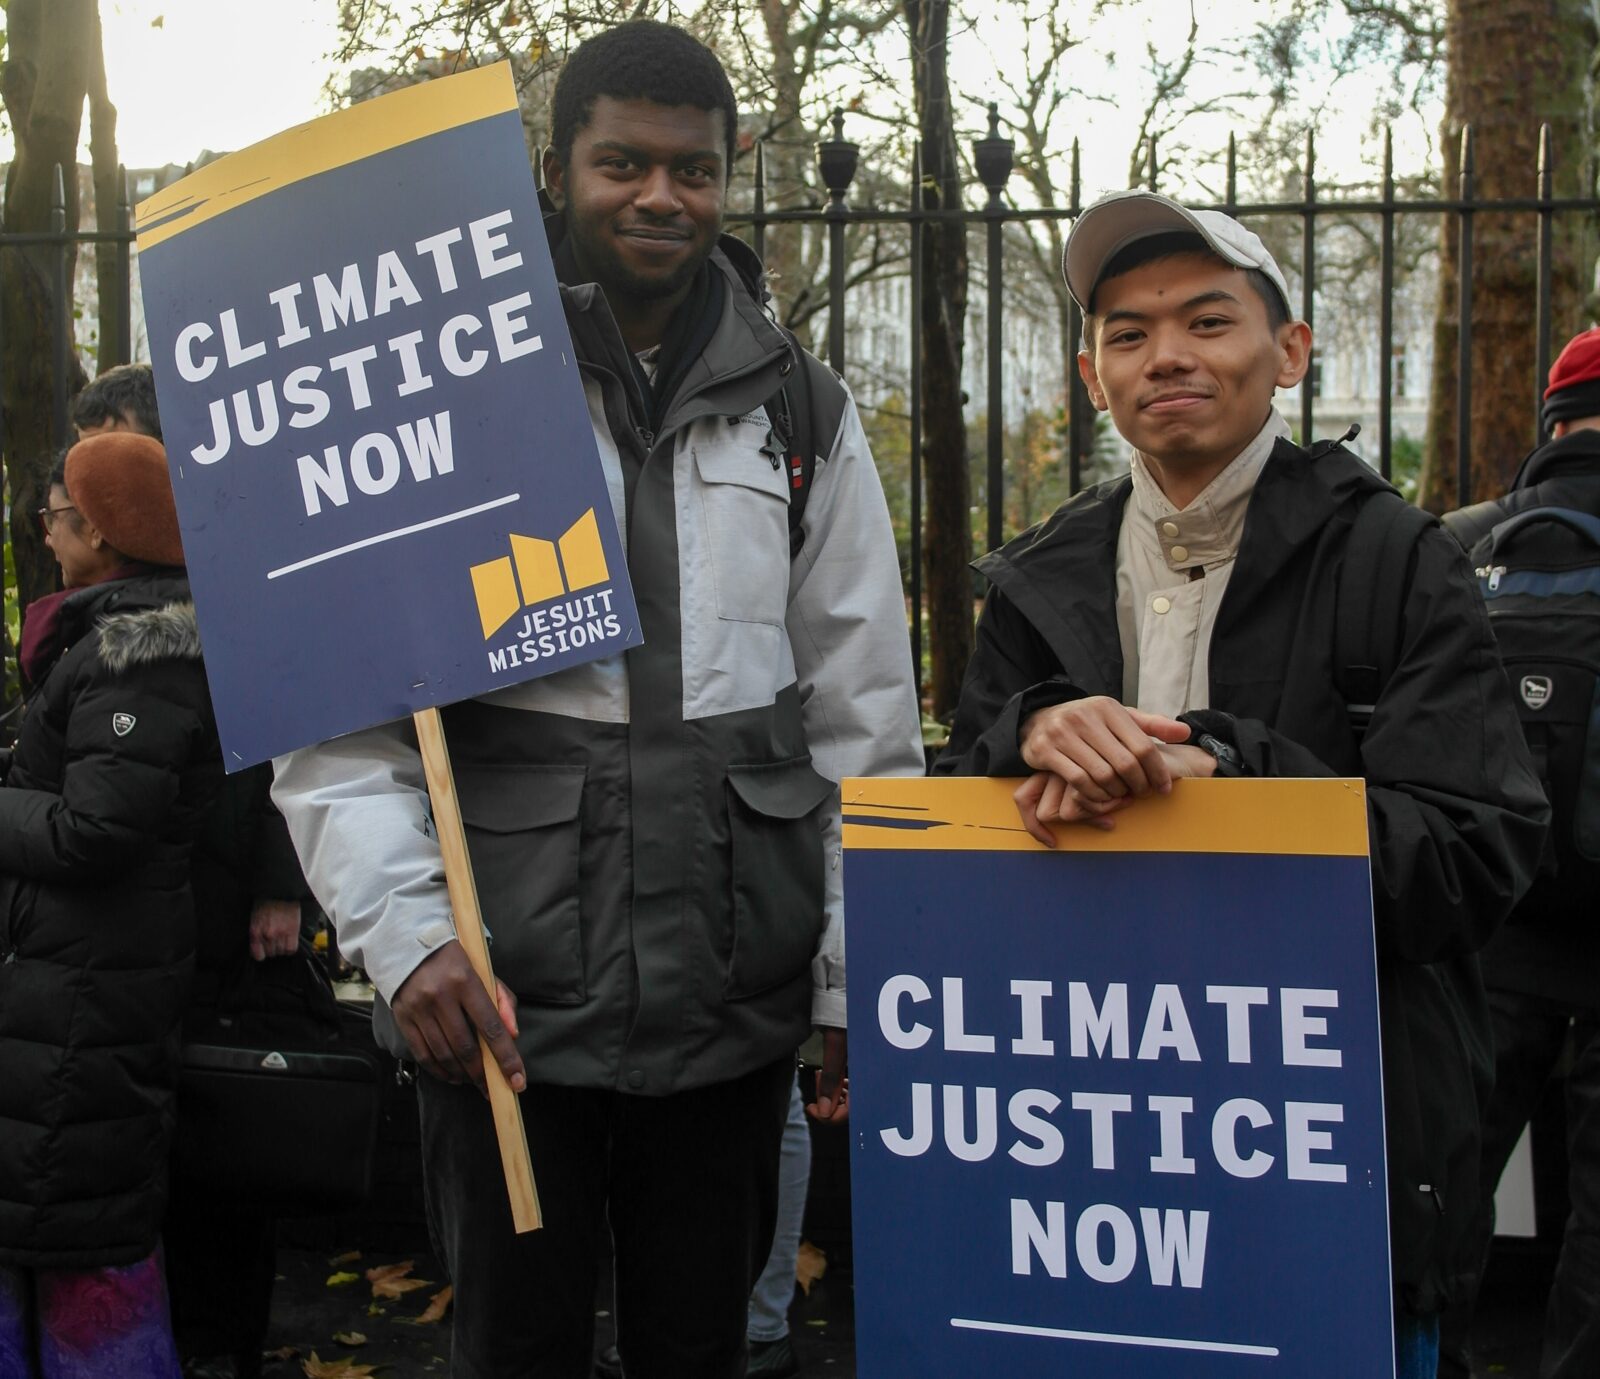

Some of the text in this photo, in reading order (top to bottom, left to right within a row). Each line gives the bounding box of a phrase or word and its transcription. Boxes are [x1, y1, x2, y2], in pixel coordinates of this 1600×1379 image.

[174, 208, 524, 384] CLIMATE
[190, 291, 544, 466] JUSTICE
[296, 409, 455, 517] NOW
[487, 613, 621, 674] MISSIONS
[516, 588, 613, 639] JESUIT
[877, 974, 1343, 1068] CLIMATE
[879, 1082, 1348, 1183] JUSTICE
[1010, 1198, 1210, 1289] NOW
